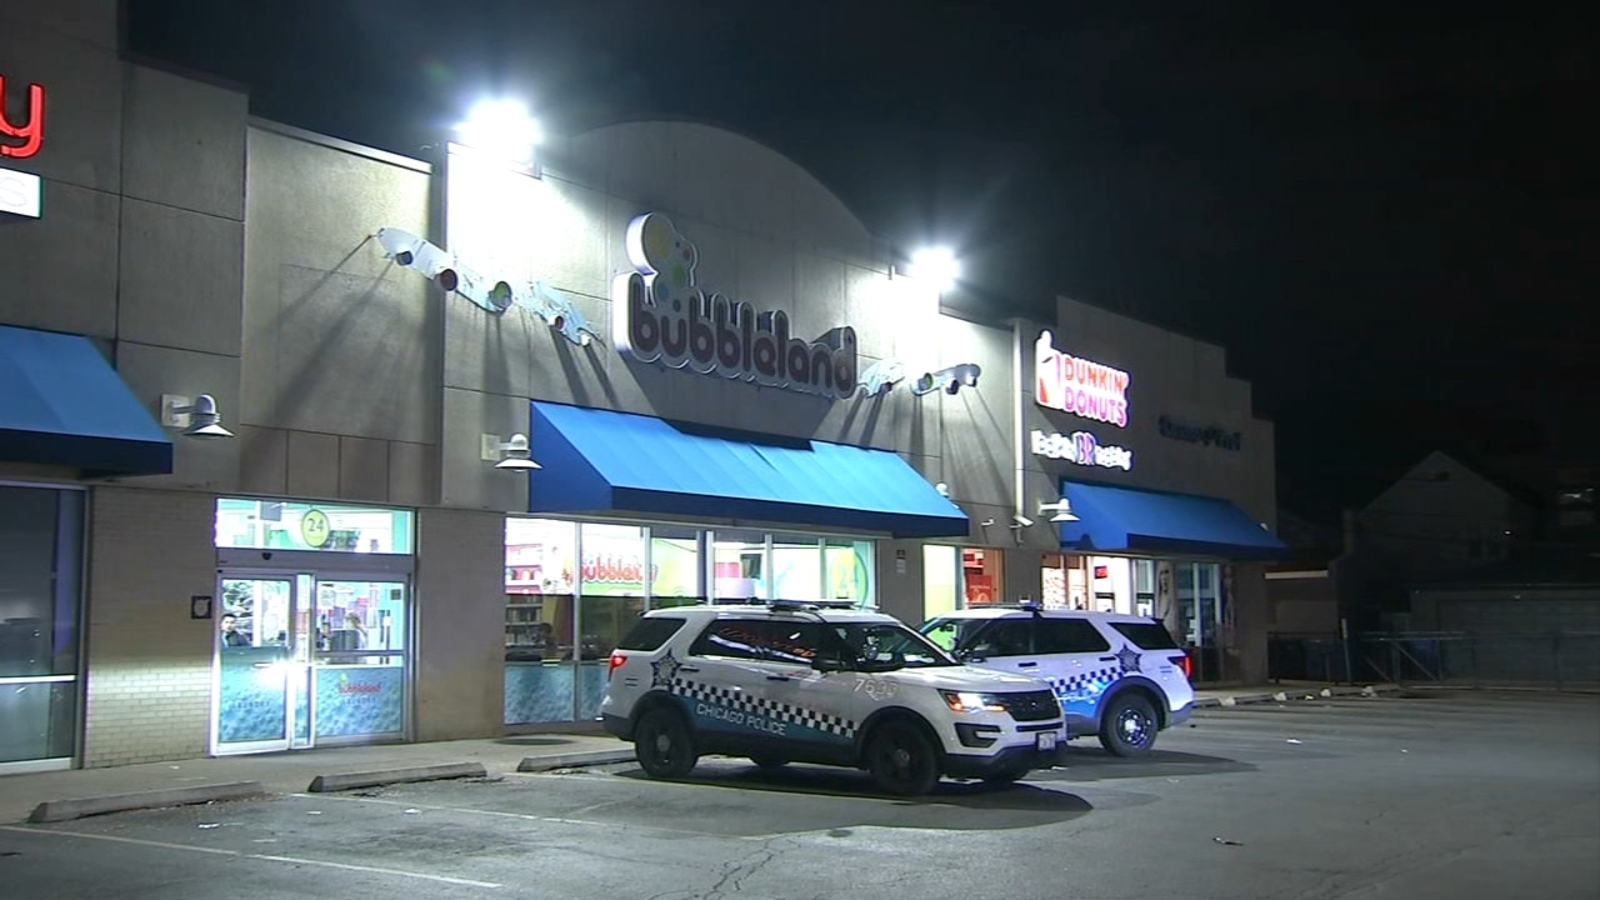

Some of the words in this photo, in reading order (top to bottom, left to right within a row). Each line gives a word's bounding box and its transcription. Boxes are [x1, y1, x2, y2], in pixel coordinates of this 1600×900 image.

[630, 276, 857, 395] bubbleland
[1064, 356, 1127, 394] DUNKIN'
[1064, 386, 1125, 425] DONUTS
[307, 517, 324, 532] 24
[696, 703, 745, 725] CHICAGO
[746, 715, 787, 736] POLICE
